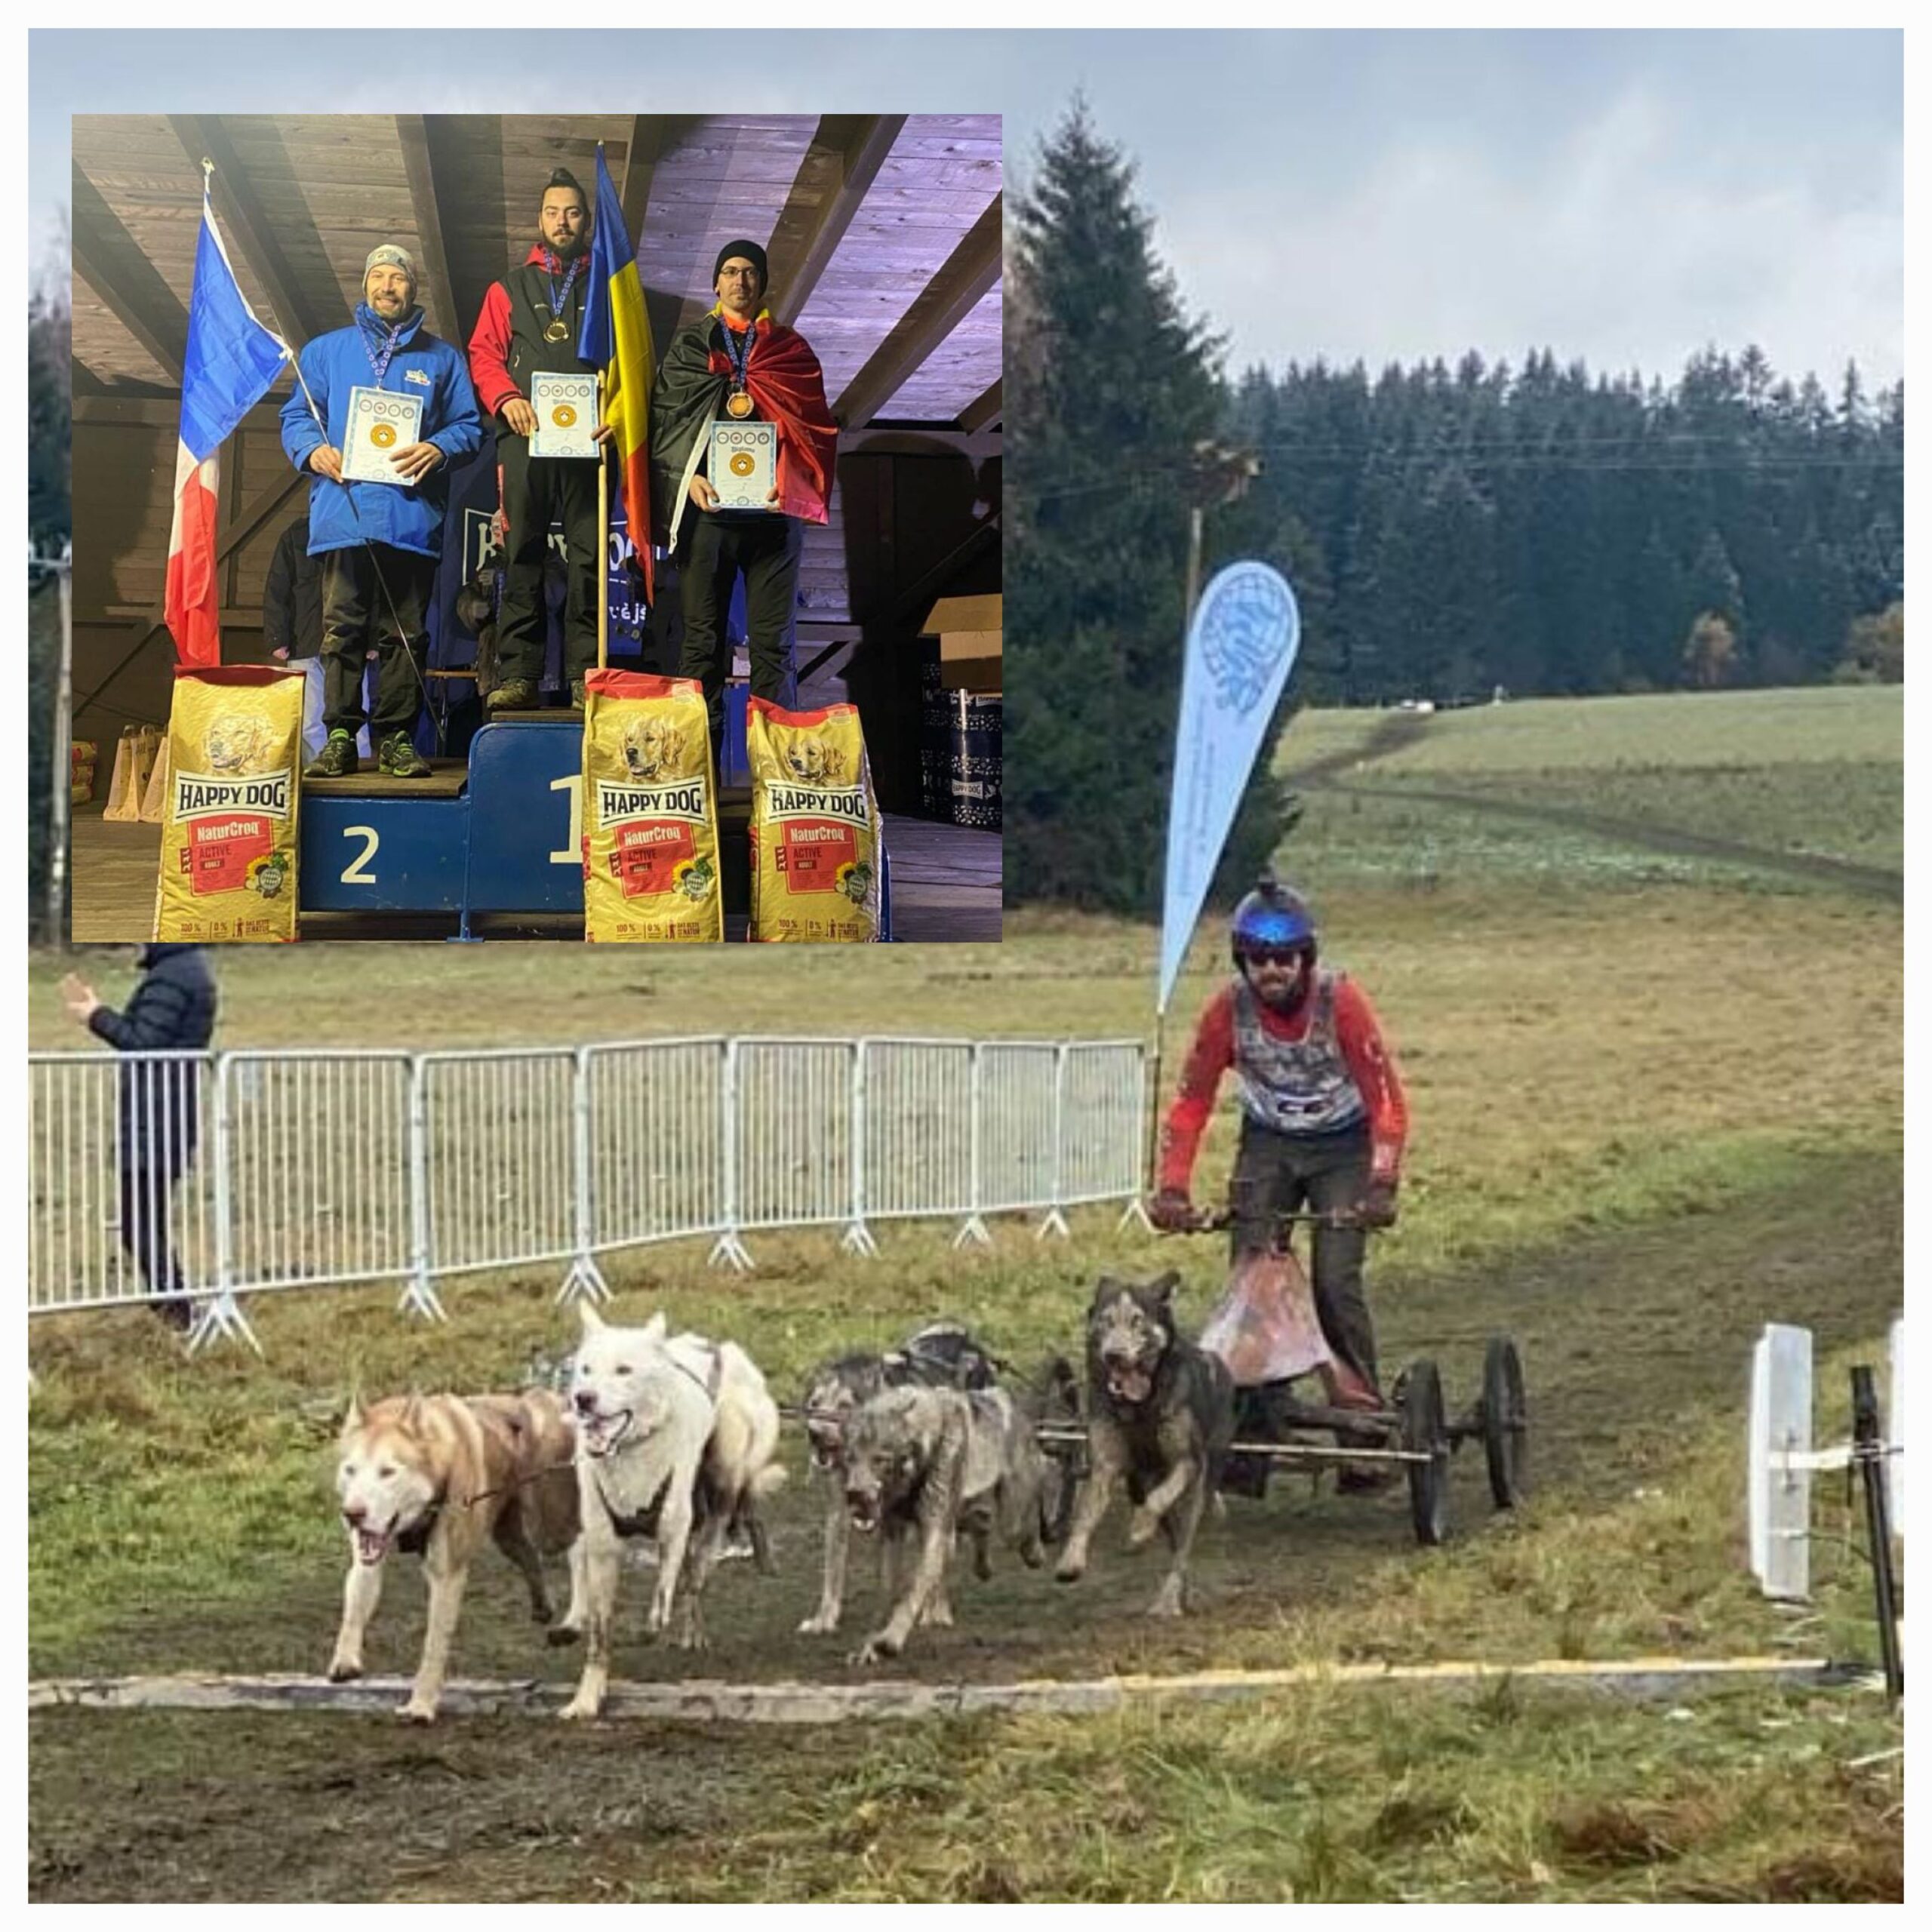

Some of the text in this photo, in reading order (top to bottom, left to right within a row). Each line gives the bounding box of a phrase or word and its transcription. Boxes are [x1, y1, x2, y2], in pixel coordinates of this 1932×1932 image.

[180, 780, 285, 811] HAPPY DOG
[603, 787, 702, 818] HAPPY DOG
[771, 789, 866, 819] HAPPY DOG
[550, 774, 583, 863] 1
[197, 821, 260, 842] NaturCroq
[624, 826, 681, 846] NaturCroq
[790, 826, 845, 843] NaturCroq
[199, 844, 232, 858] ACTIVE
[340, 826, 379, 884] 2
[628, 848, 657, 862] ACTIVE
[793, 847, 823, 858] ACTIVE
[616, 924, 628, 933] 100
